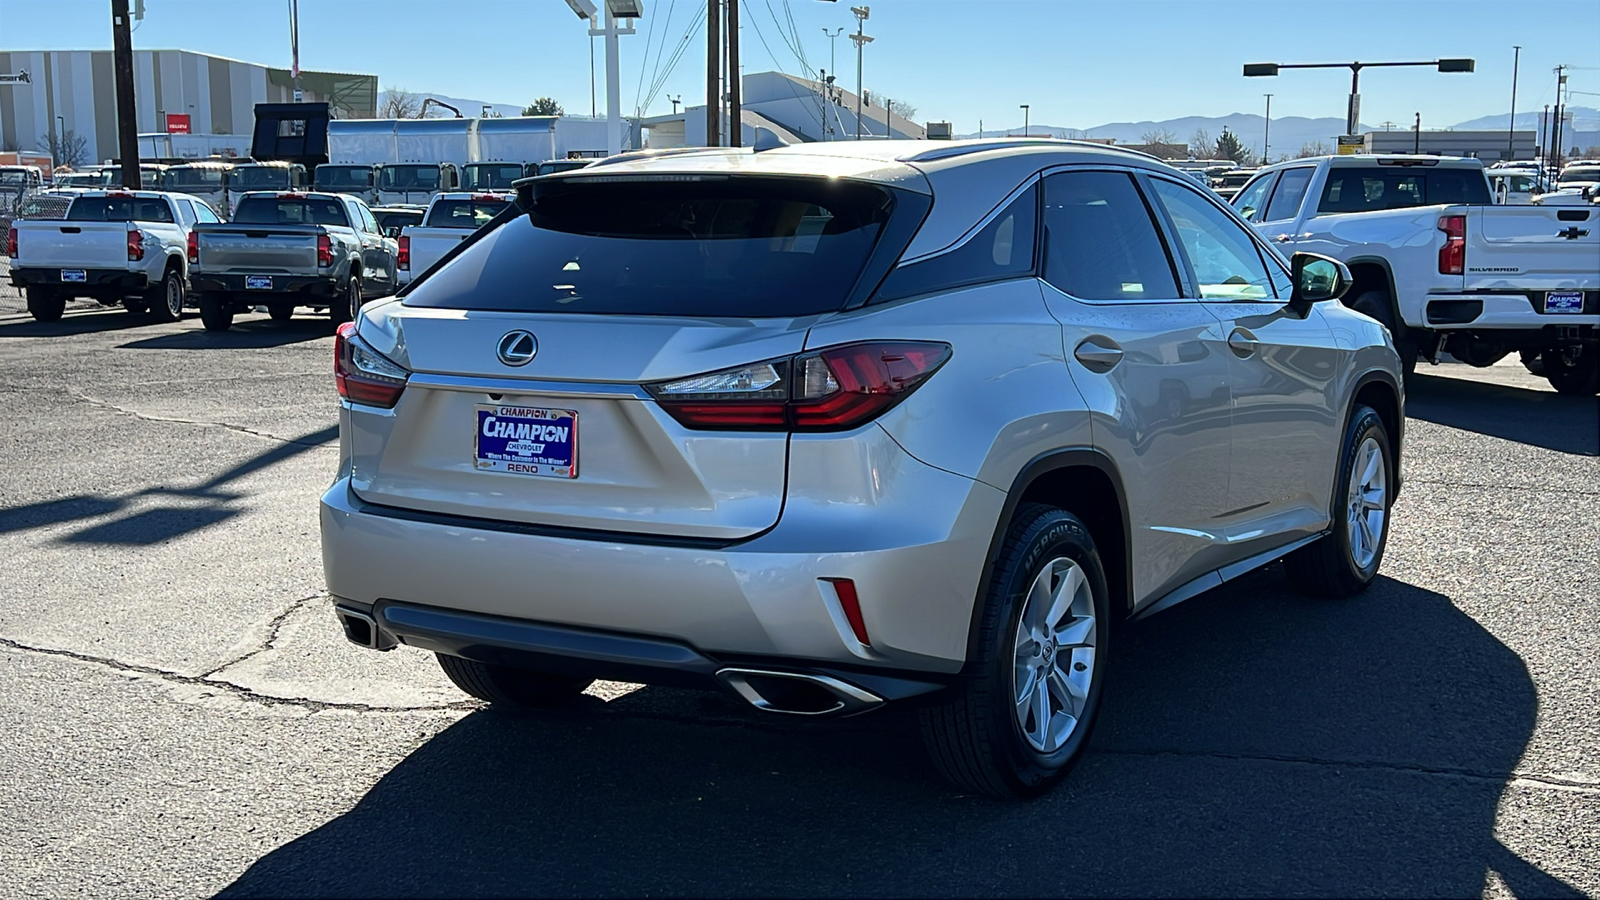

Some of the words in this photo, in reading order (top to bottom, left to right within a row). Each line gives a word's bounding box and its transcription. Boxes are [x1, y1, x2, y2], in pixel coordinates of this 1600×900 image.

[500, 407, 547, 419] CHAMPION
[483, 416, 569, 443] CHAMPION
[508, 443, 542, 452] CHEVROLET
[512, 455, 534, 463] Customer
[508, 464, 539, 474] RENO
[1025, 524, 1084, 570] HERCULES
